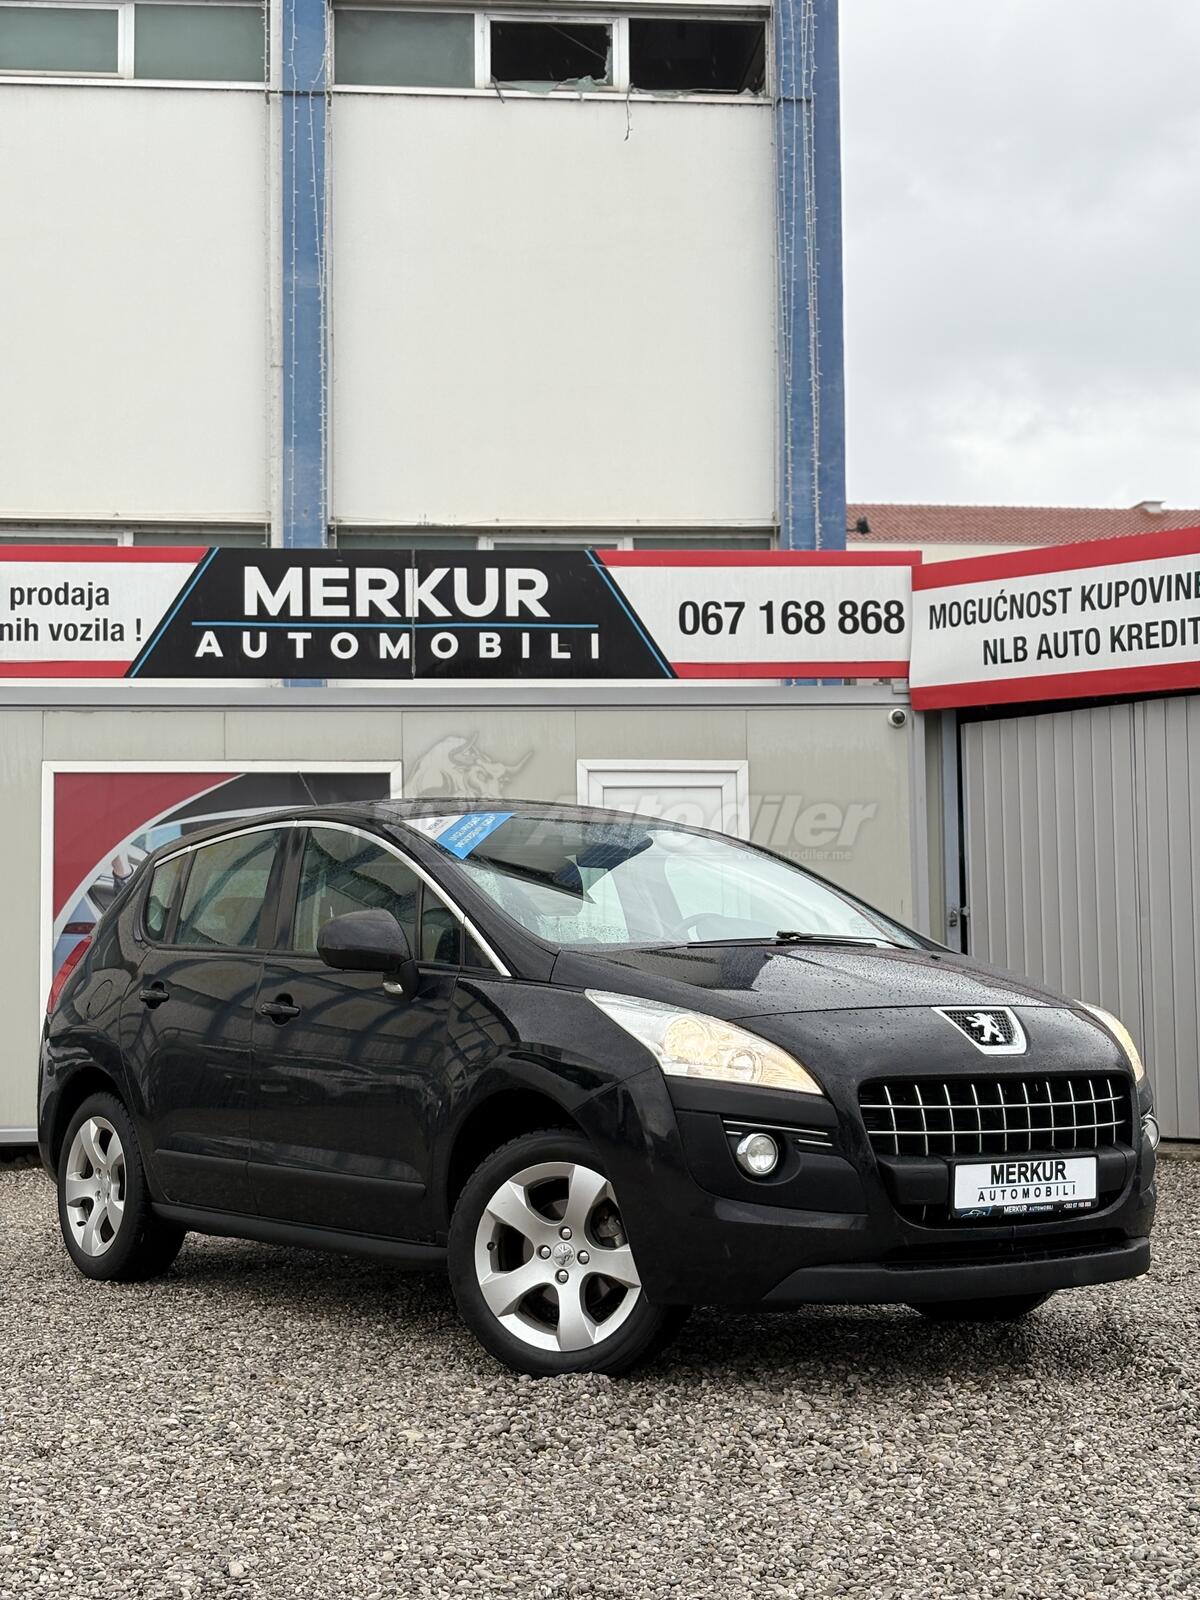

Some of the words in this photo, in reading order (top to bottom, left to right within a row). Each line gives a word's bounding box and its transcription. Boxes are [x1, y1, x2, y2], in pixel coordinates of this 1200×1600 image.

[10, 582, 110, 611] prodaja
[244, 566, 550, 618] MERKUR
[678, 600, 746, 635] 067
[759, 600, 826, 635] 168
[837, 600, 905, 635] 868
[928, 587, 1072, 630] MOGUĆNOST
[48, 618, 125, 642] vozila
[135, 618, 142, 642] !
[983, 635, 1028, 666] NLB
[1036, 627, 1101, 660] AUTO
[1109, 616, 1200, 653] KREDIT
[195, 631, 600, 660] AUTOMOBILI
[990, 1160, 1067, 1186] MERKUR
[977, 1184, 1076, 1203] AUTOMOBILI
[1003, 1205, 1028, 1214] MERKUR
